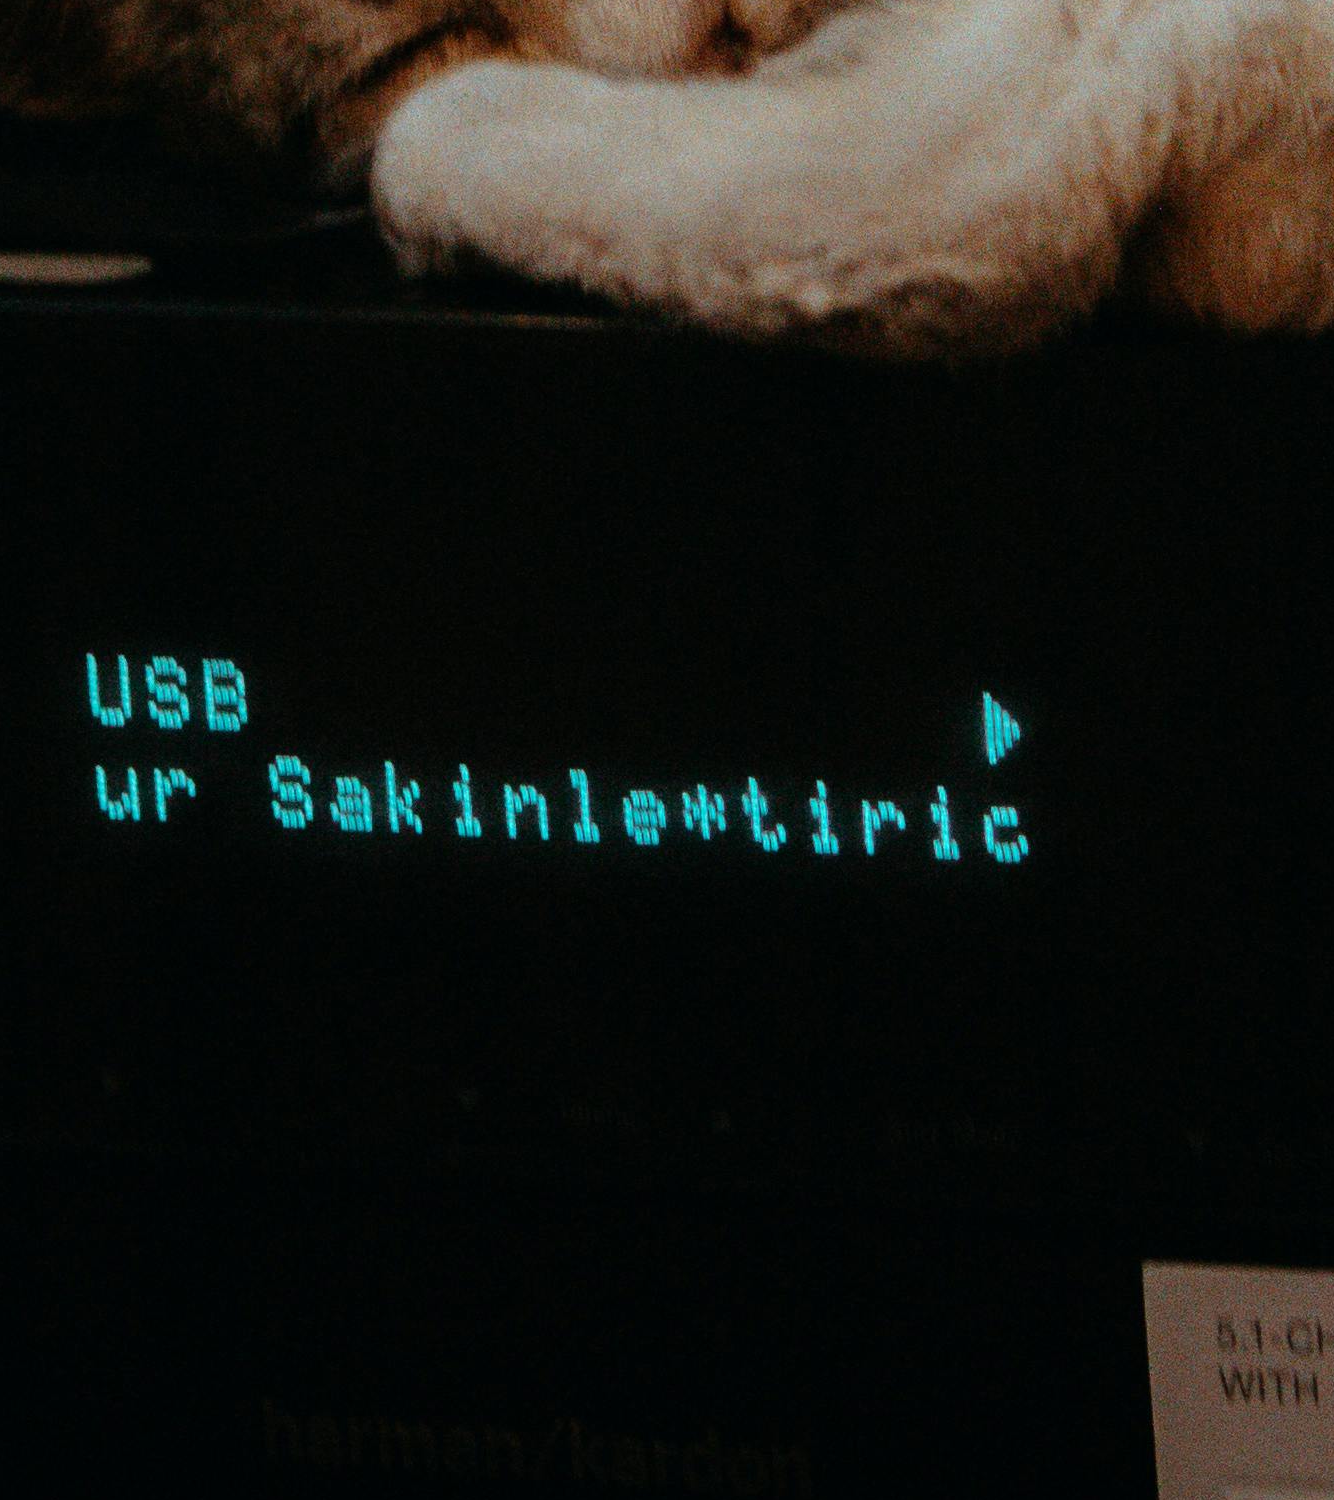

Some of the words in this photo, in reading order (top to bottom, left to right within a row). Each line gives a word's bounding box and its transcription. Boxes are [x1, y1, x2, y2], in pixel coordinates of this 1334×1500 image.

[86, 653, 249, 732] USB
[96, 765, 196, 822] ur
[1217, 1364, 1320, 1410] WITH
